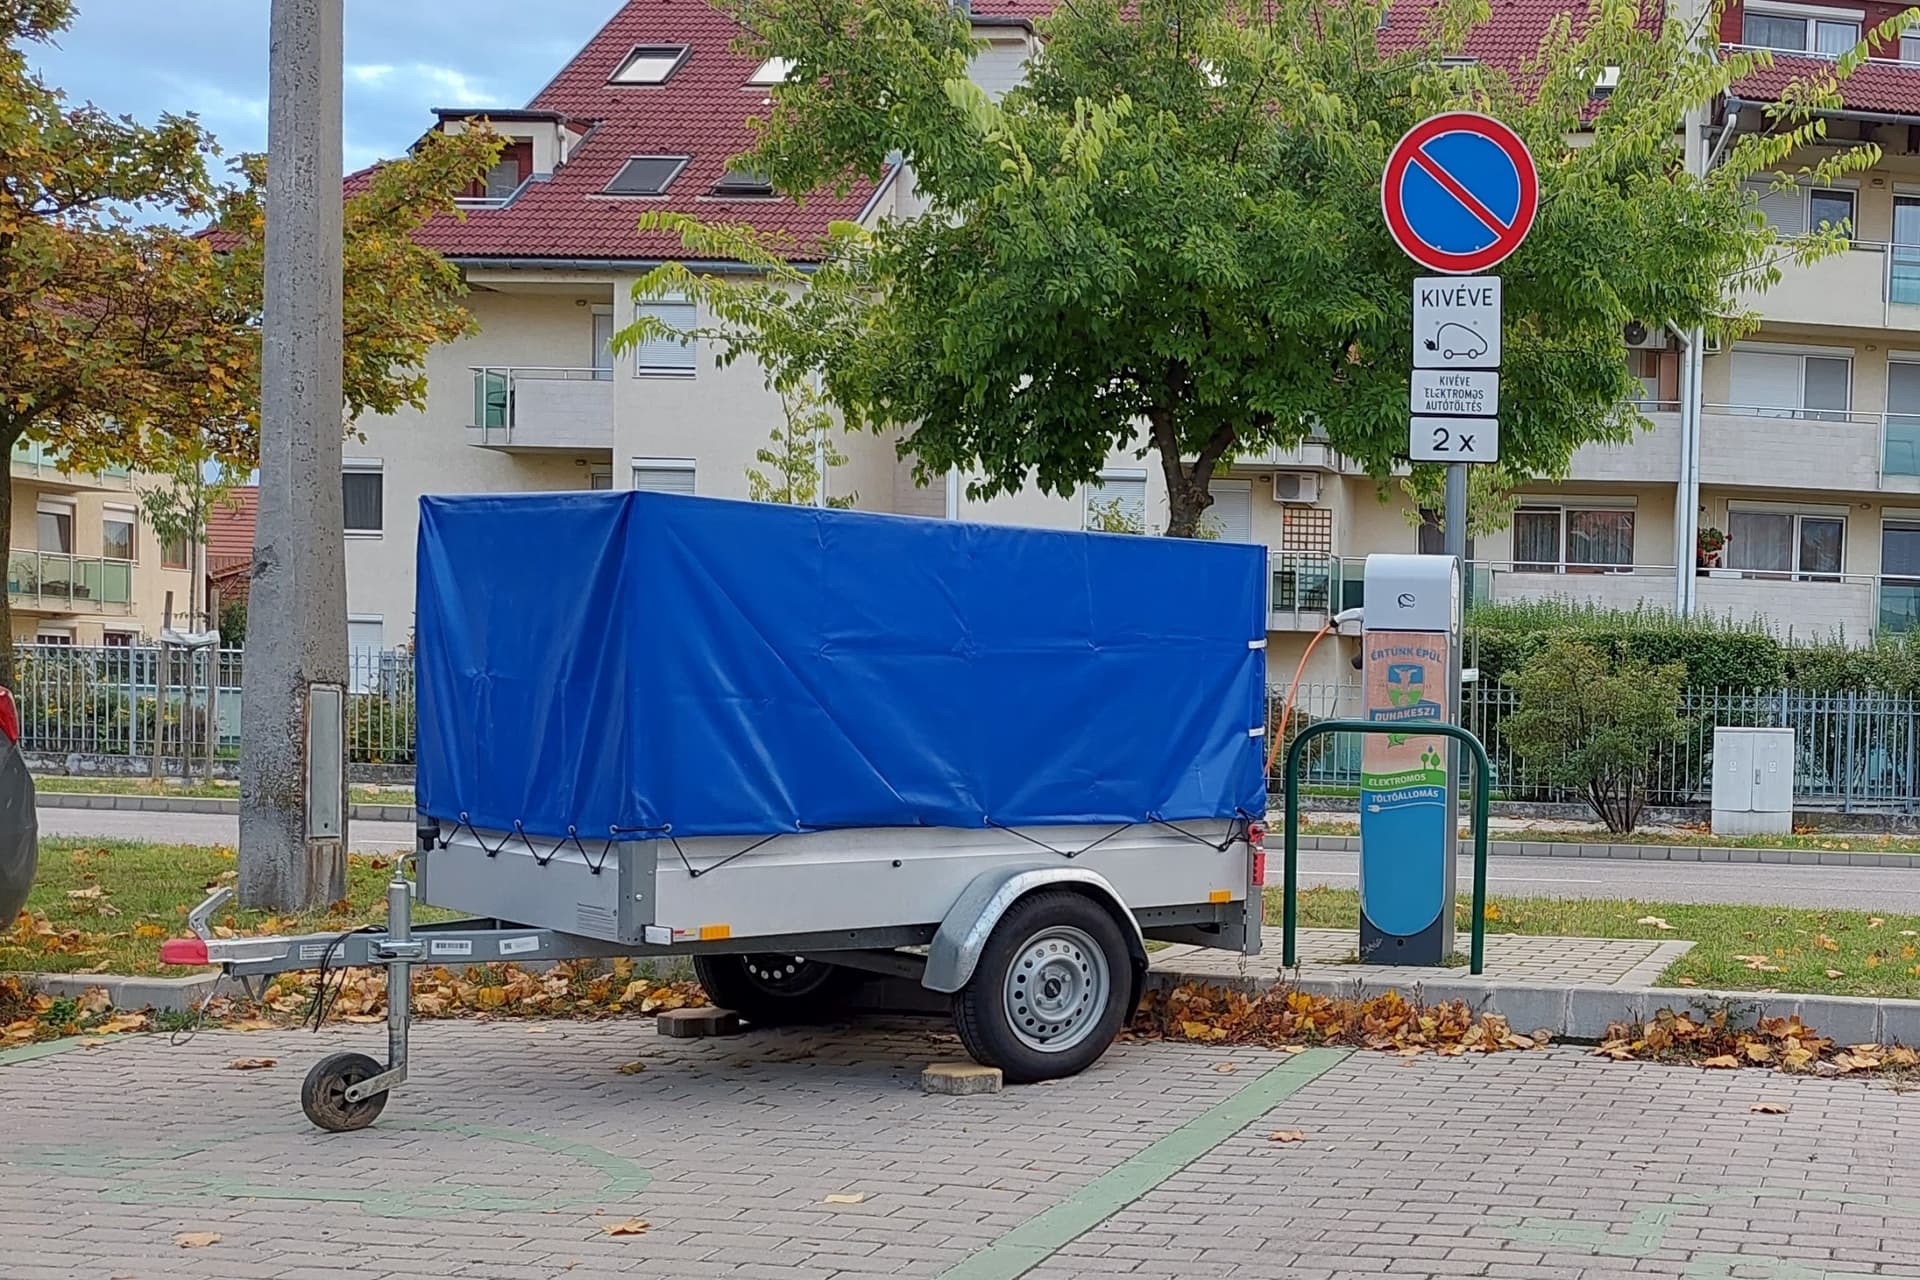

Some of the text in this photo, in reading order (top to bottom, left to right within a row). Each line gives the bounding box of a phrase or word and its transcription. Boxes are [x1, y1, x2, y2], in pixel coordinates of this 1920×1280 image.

[1422, 284, 1493, 307] KIVÉVE
[1439, 374, 1471, 387] KIVÉVE
[1424, 388, 1484, 400] ELEKTROMOS
[1426, 399, 1482, 412] AUTÓTÖLTÉS
[1433, 427, 1449, 451] 2
[1375, 708, 1435, 721] DUNAKESZI
[1368, 773, 1426, 786] ELEKTROMOS
